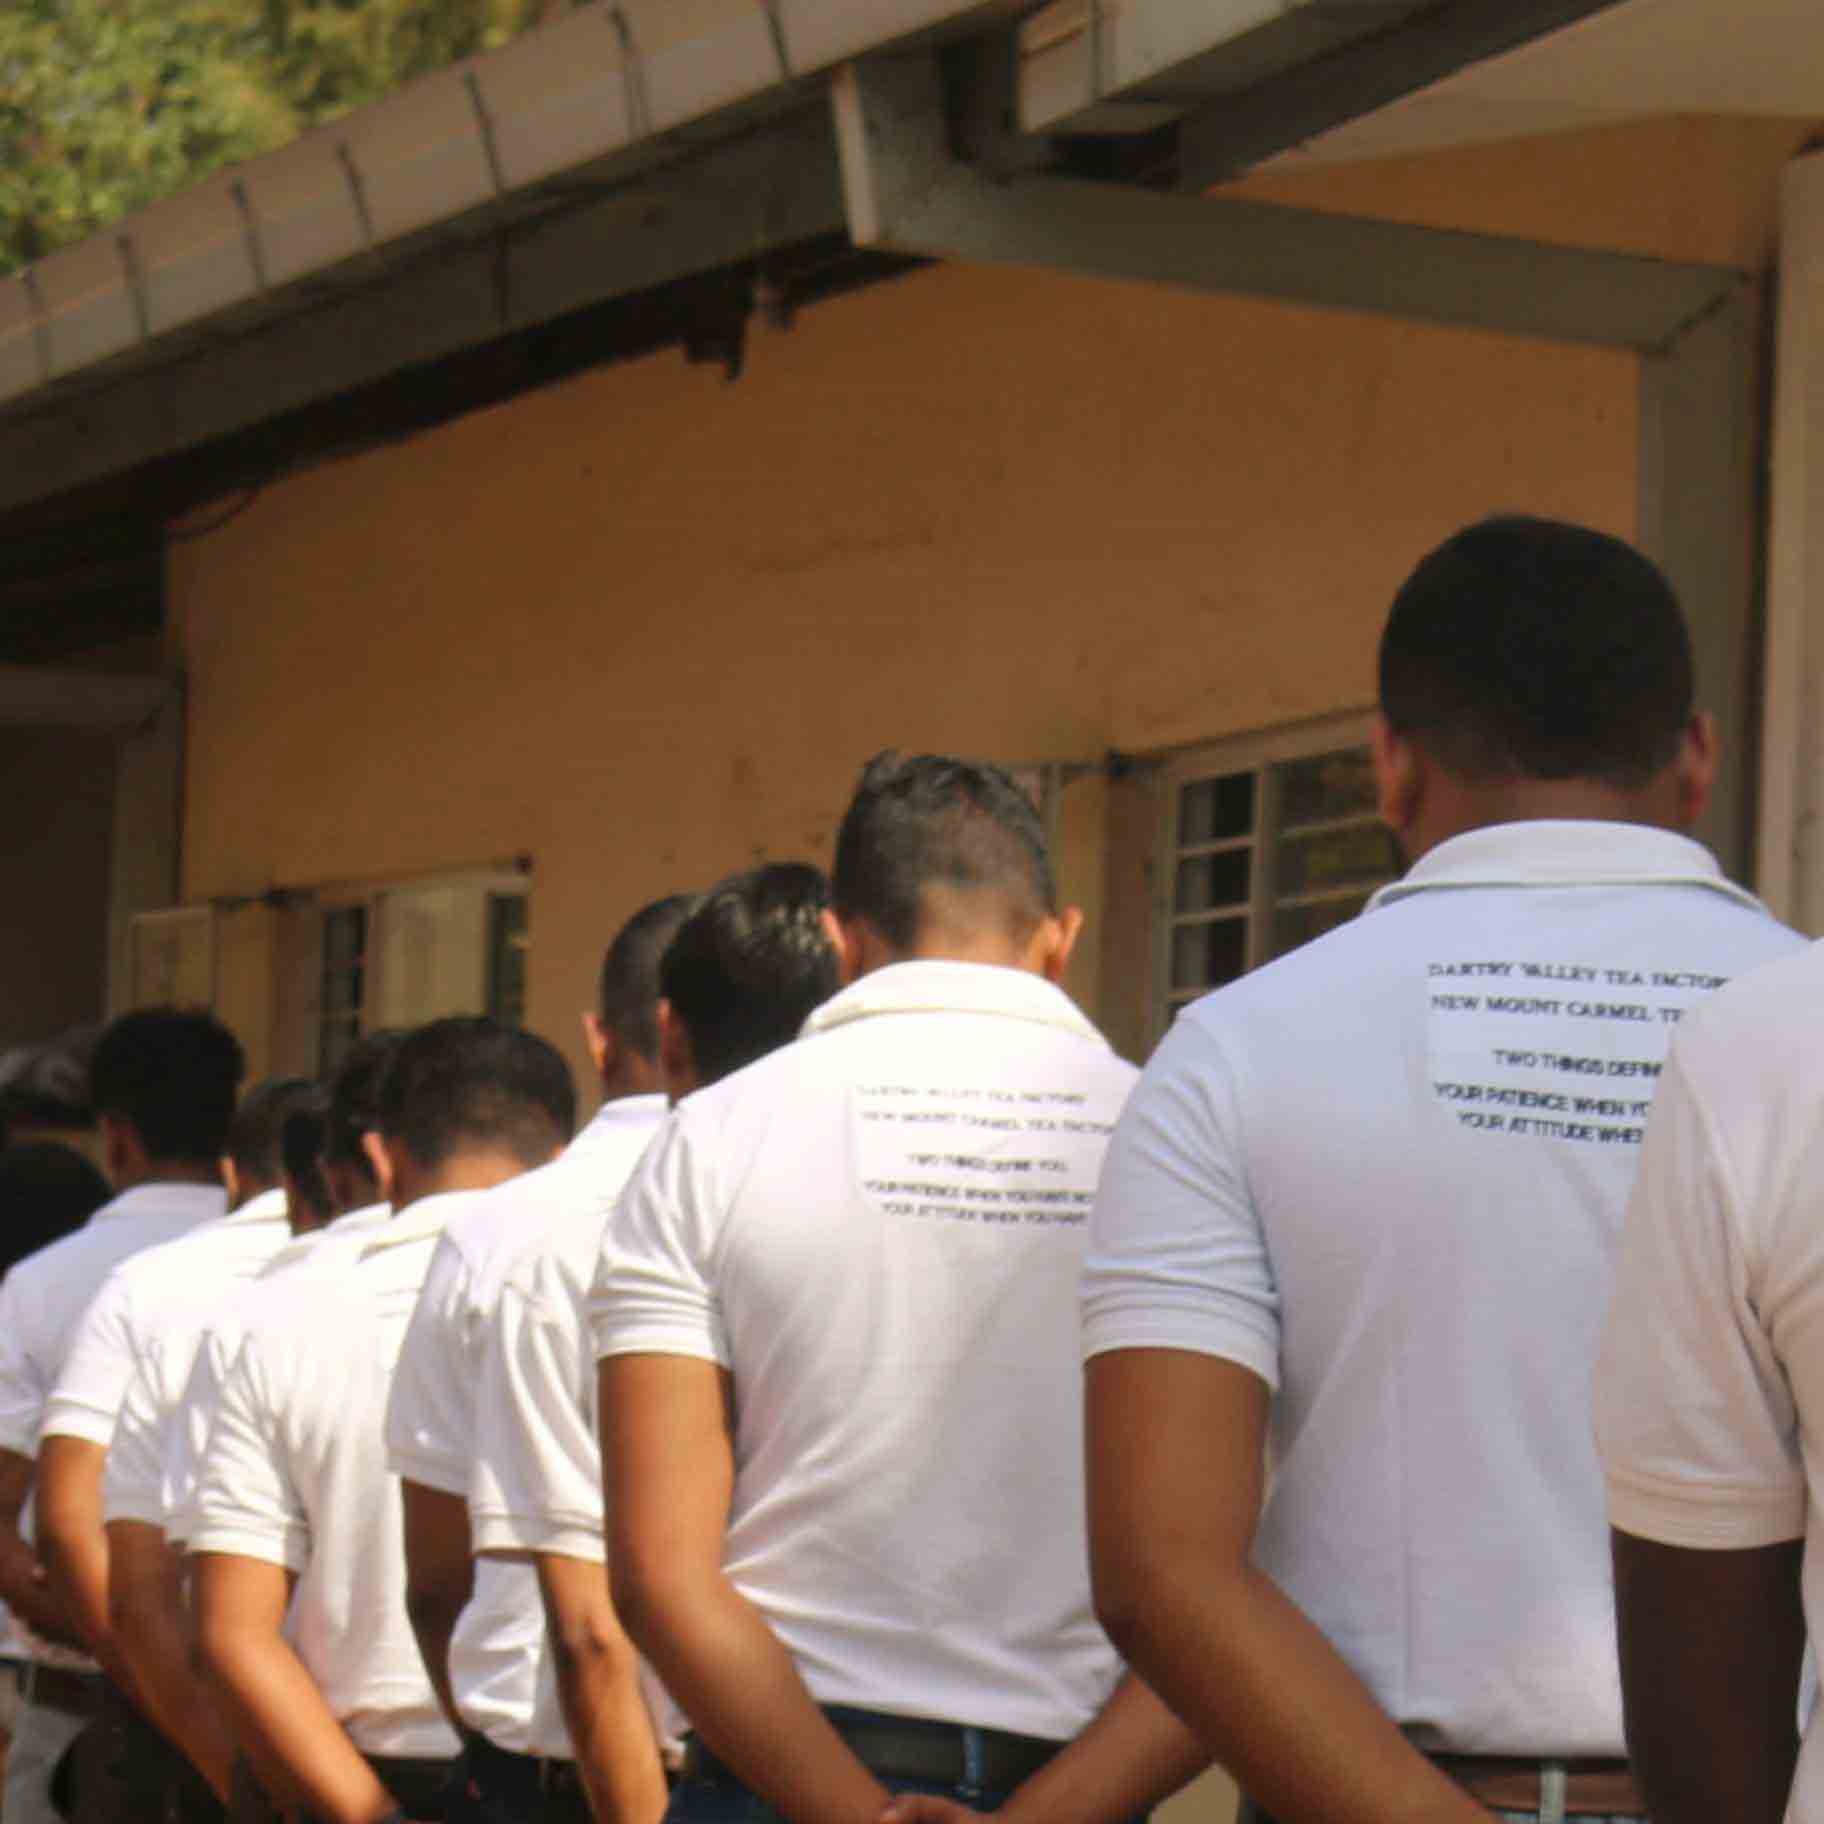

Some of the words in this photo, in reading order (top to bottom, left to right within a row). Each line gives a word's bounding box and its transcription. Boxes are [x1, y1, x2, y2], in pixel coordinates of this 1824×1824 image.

[1604, 970, 1643, 986] TEA
[1493, 1049, 1537, 1069] TWO
[1434, 1082, 1483, 1102] YOUR
[1573, 1097, 1626, 1117] WHEN
[1459, 1112, 1505, 1132] YOUR
